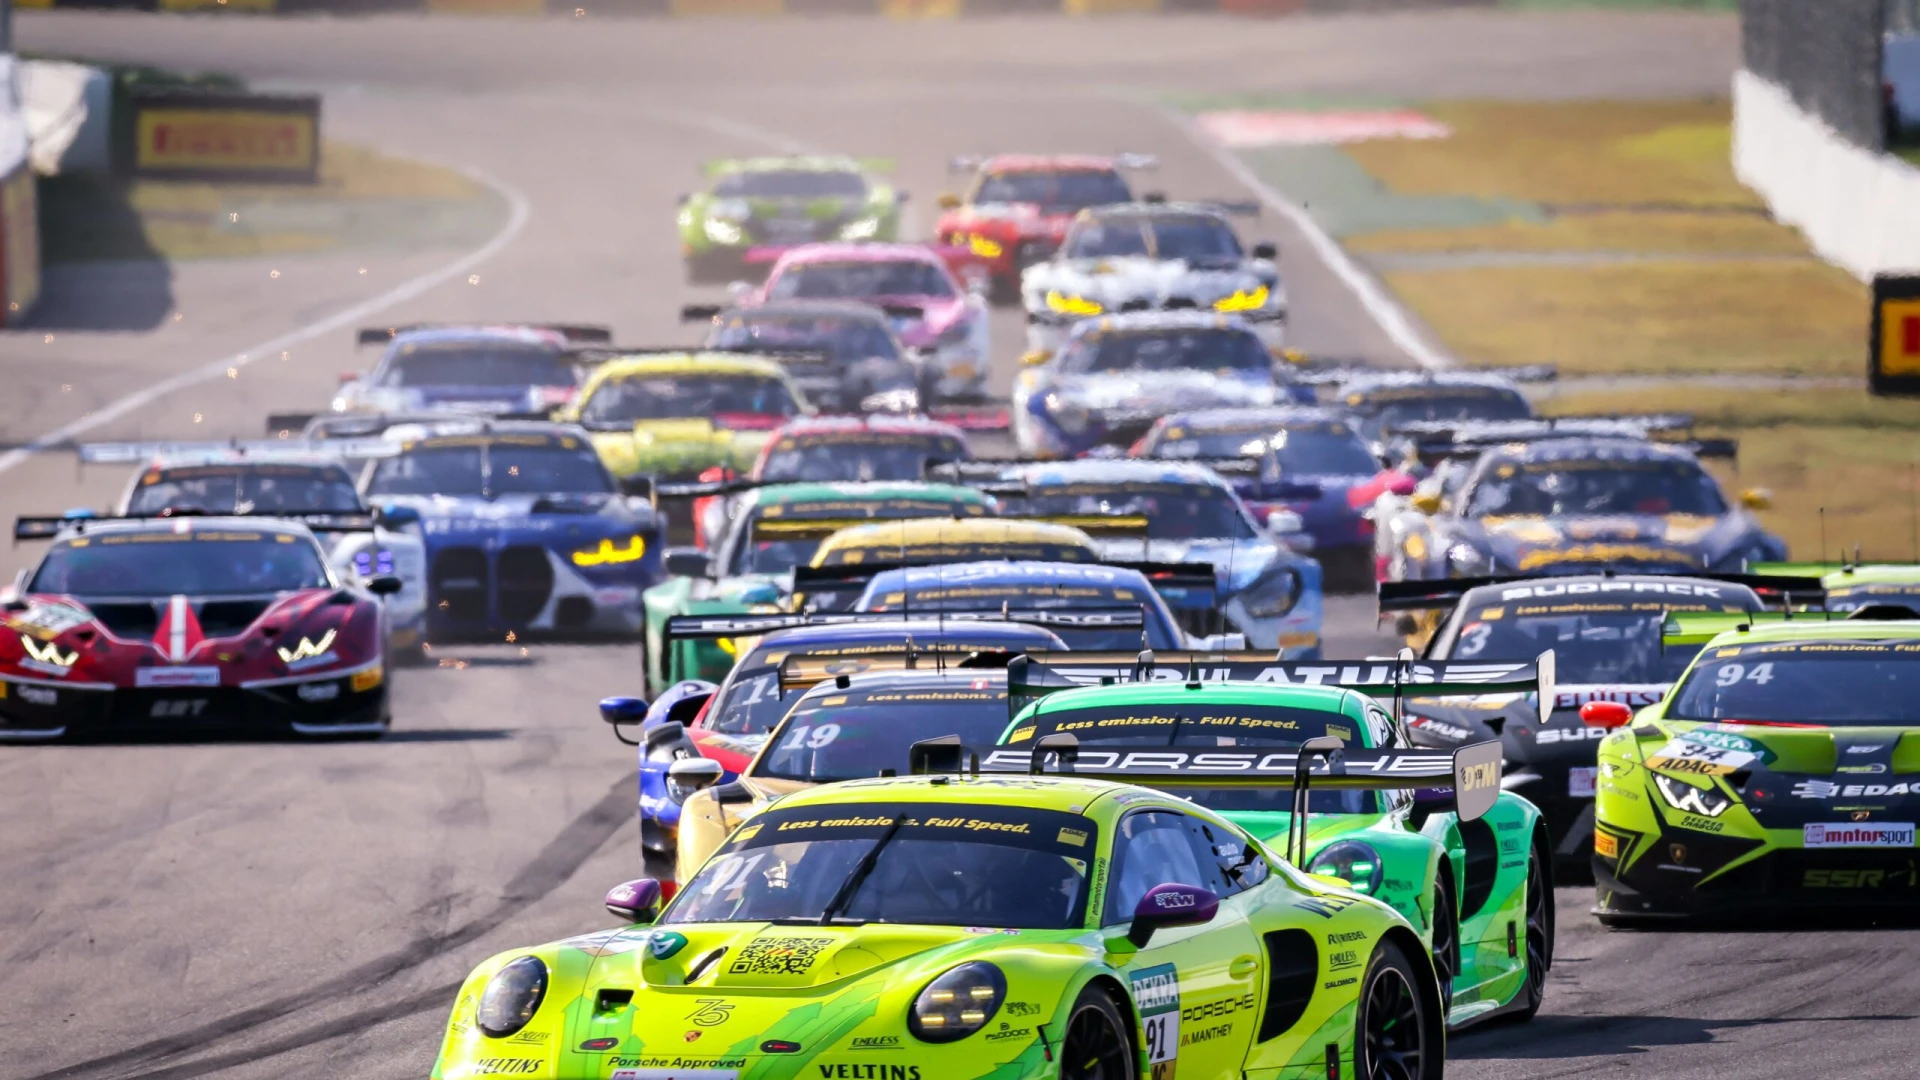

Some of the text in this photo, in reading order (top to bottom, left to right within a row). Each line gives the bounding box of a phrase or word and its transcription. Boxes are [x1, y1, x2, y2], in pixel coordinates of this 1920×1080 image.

[1502, 582, 1721, 600] SUDPACK
[1461, 623, 1492, 656] 3
[1715, 662, 1774, 687] 94
[1055, 721, 1094, 731] Less
[1200, 716, 1236, 725] Full
[1239, 718, 1300, 730] Speed.
[781, 723, 841, 749] 19
[983, 750, 1454, 771] PORSCHE
[1681, 744, 1729, 760] 94
[1657, 757, 1717, 774] ADAC
[1463, 762, 1497, 791] DTM
[777, 819, 818, 831] Less
[924, 817, 961, 828] Full
[963, 819, 1030, 834] Speed.
[1825, 828, 1913, 845] motorsport
[684, 999, 735, 1026] 75
[1182, 993, 1255, 1024] PORSCHE
[852, 1036, 901, 1048] ENDLESS
[1146, 1017, 1166, 1060] 91
[1191, 1023, 1233, 1044] MANTHEY
[475, 1058, 545, 1074] VELTINS
[608, 1056, 746, 1069] Porsche Approved
[819, 1064, 921, 1080] VELTINS
